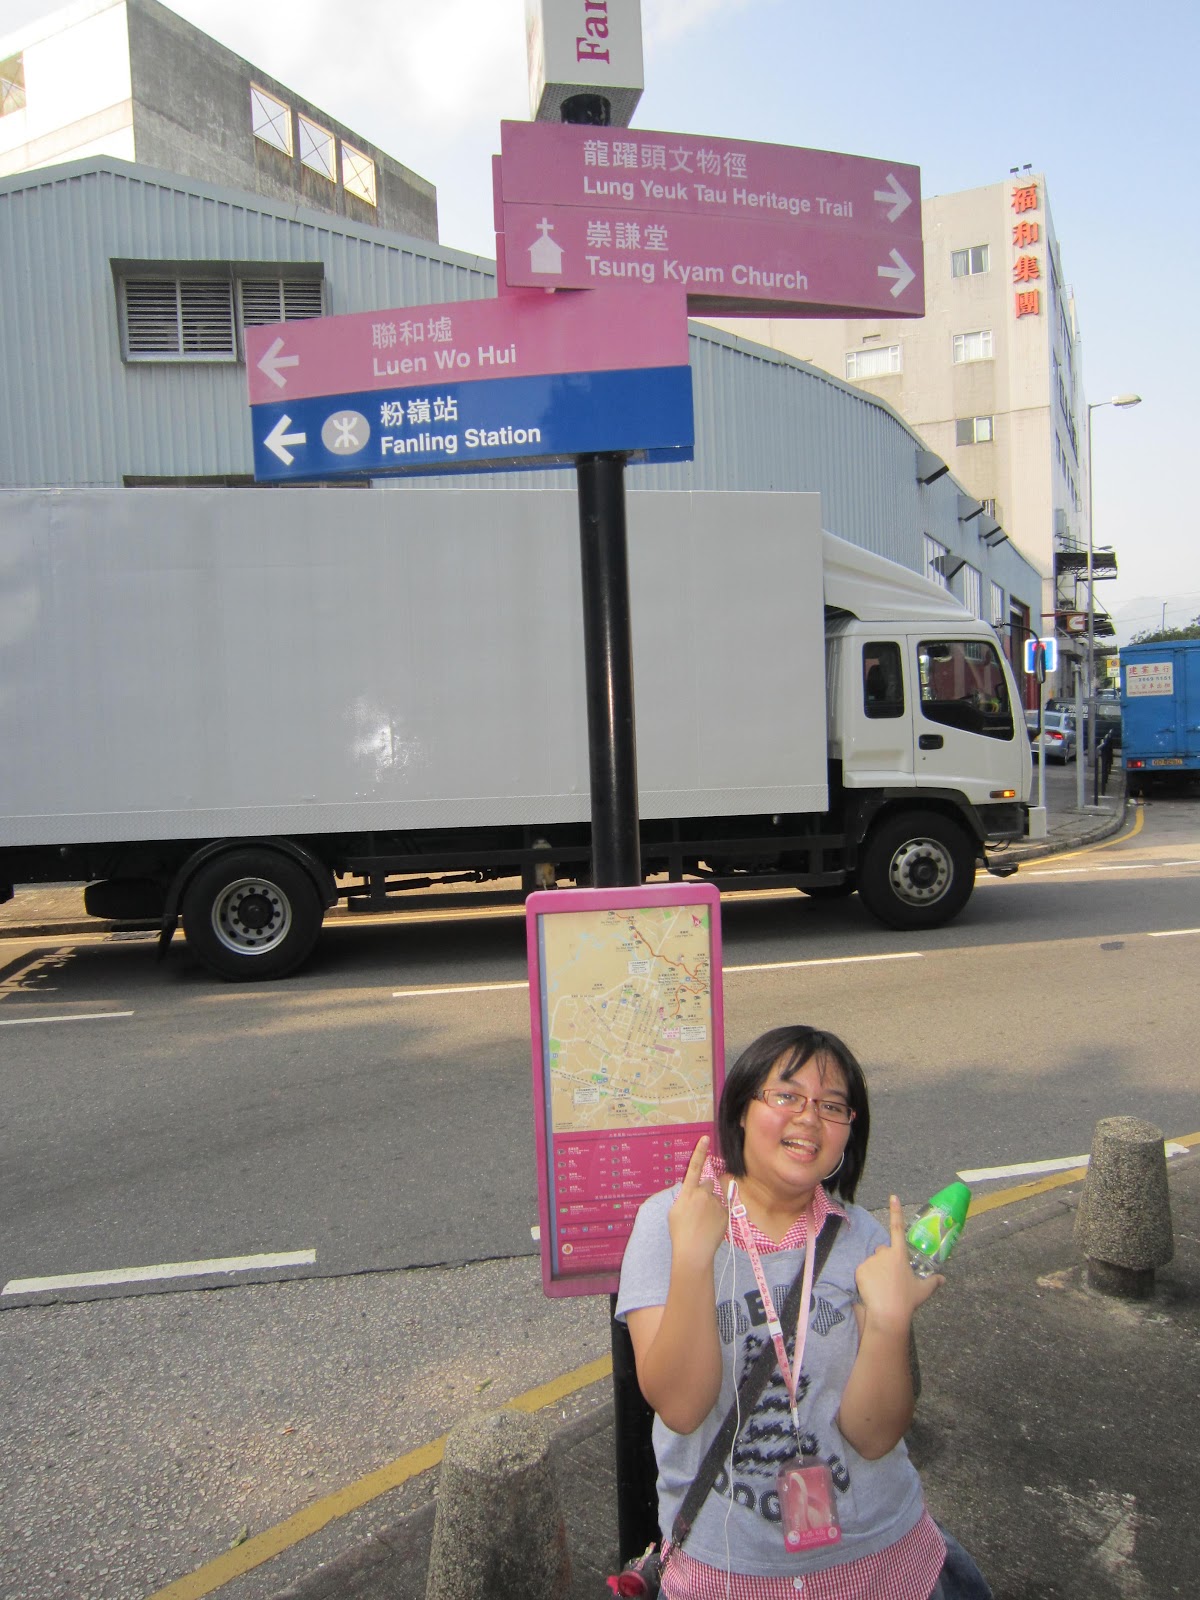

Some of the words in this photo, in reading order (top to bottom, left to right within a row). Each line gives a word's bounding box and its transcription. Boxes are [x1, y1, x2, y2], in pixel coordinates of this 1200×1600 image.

[583, 140, 748, 180] 龍躍頭文物徑
[583, 176, 634, 200] Lung
[640, 180, 688, 201] Yeuk
[694, 184, 727, 205] Tau
[733, 188, 810, 215] Heritage
[816, 198, 853, 218] Trail
[586, 221, 669, 251] 崇謙堂
[1011, 183, 1040, 319] 福和集團
[585, 256, 655, 283] Tsung
[663, 260, 724, 285] Kyam
[731, 265, 808, 290] Church
[371, 316, 453, 349] 聯和墟
[373, 356, 427, 377] Luen
[434, 349, 471, 370] Wo
[478, 344, 517, 366] Hui
[380, 396, 458, 427] 粉嶺站
[380, 433, 458, 455] Fanling
[465, 425, 541, 448] Station
